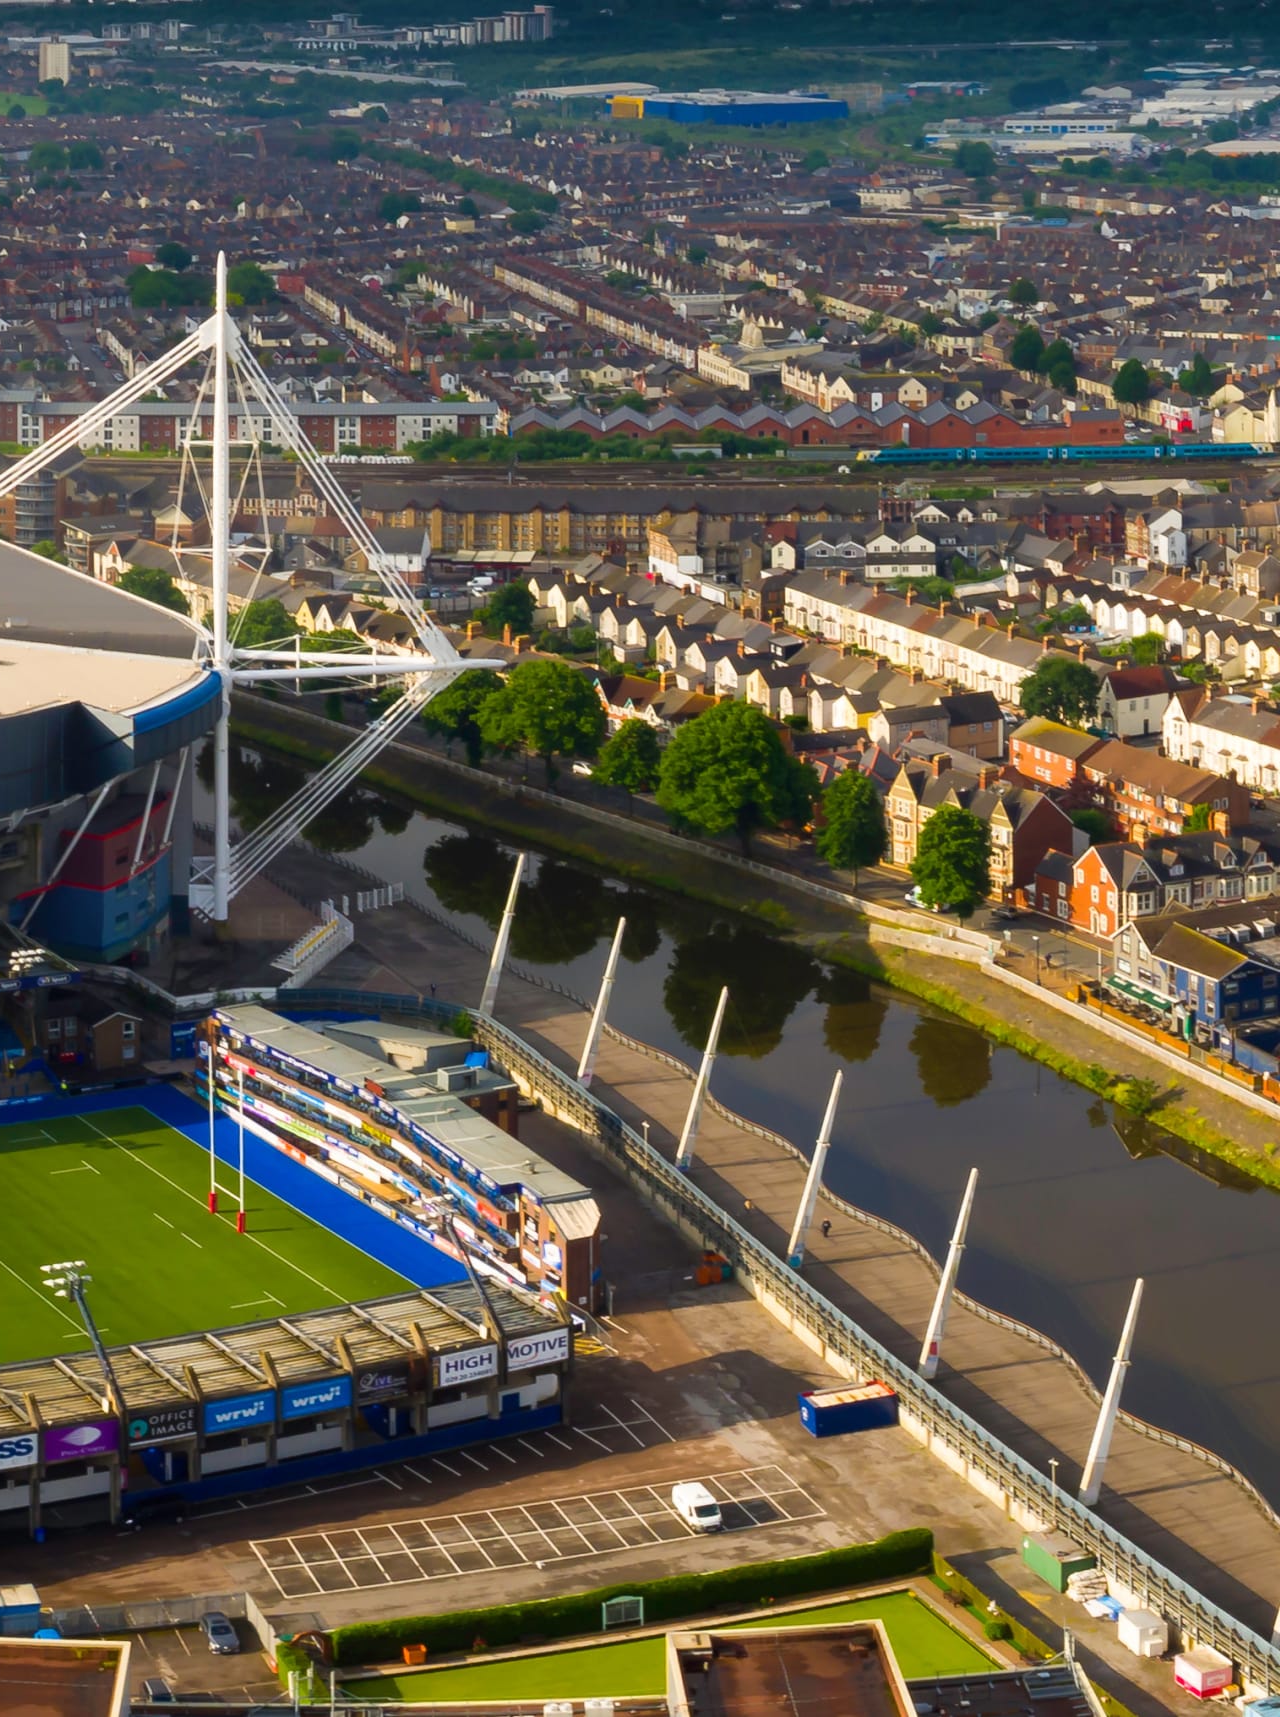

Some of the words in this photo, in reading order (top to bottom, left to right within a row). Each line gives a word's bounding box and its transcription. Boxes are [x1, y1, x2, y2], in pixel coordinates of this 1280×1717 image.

[507, 1336, 567, 1359] MOTIVE
[445, 1353, 493, 1373] HIGH
[149, 1410, 193, 1425] OFFICE
[151, 1420, 193, 1435] IMAGE
